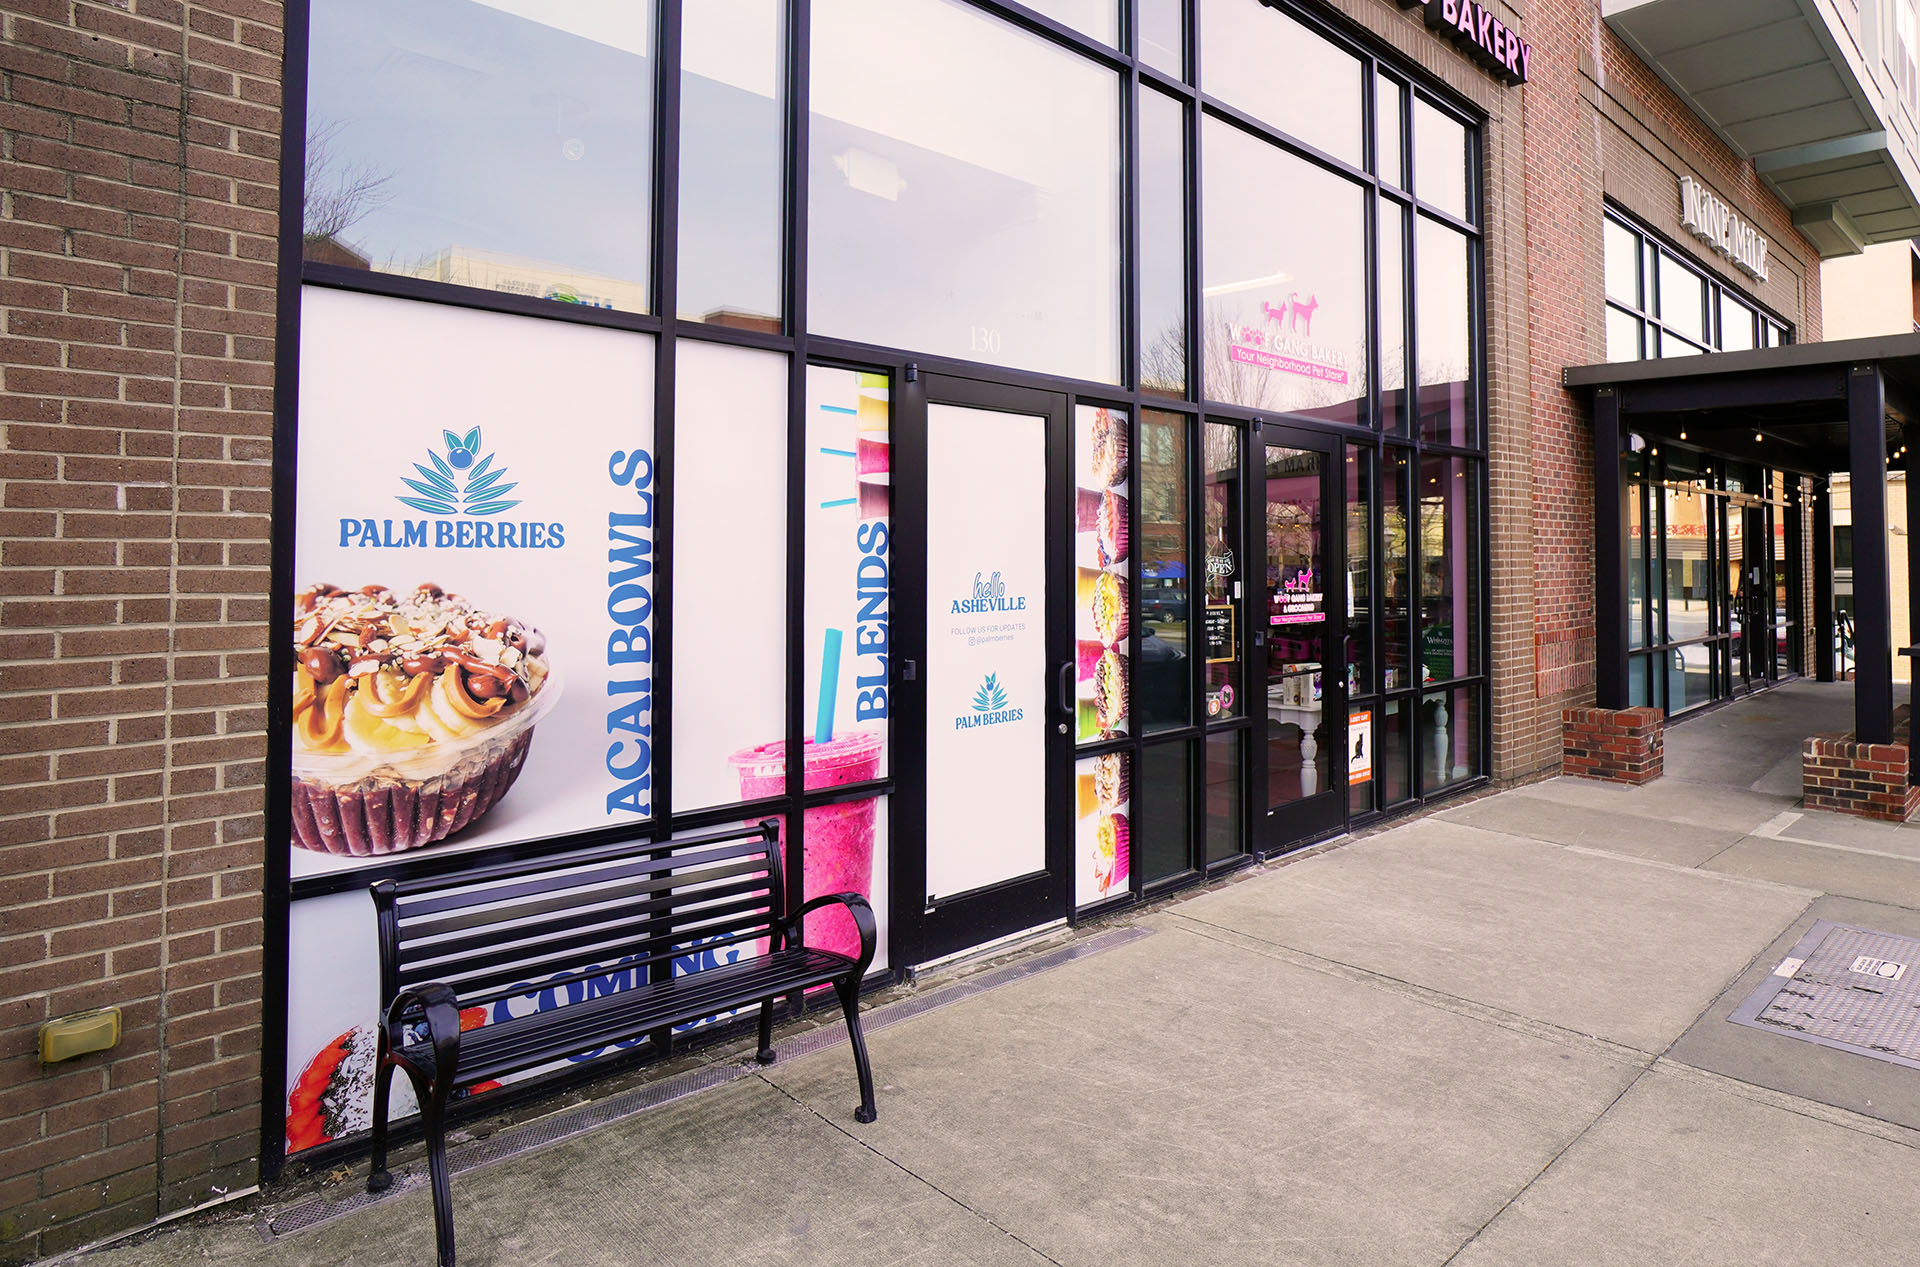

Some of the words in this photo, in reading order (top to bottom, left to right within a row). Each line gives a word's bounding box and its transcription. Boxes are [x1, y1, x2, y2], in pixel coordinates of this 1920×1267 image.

[970, 326, 1001, 354] 130
[1274, 335, 1308, 357] GANG
[1312, 343, 1347, 367] BAKERY
[1237, 348, 1255, 361] Your
[1256, 353, 1311, 375] Neighborhood
[1312, 365, 1324, 377] Pet
[339, 518, 428, 548] PALM
[435, 520, 565, 549] BERRIES
[607, 448, 653, 666] BOWLS
[1207, 561, 1233, 574] OPEN
[973, 571, 1005, 599] hello
[951, 597, 1026, 614] ASHEVILLE
[856, 521, 889, 722] BLENDS
[951, 626, 976, 635] FOLLOW
[987, 624, 998, 632] FOR
[1000, 623, 1026, 632] UPDATES
[956, 714, 981, 730] PALM
[983, 708, 1023, 726] BERRIES
[606, 677, 651, 817] ACAI
